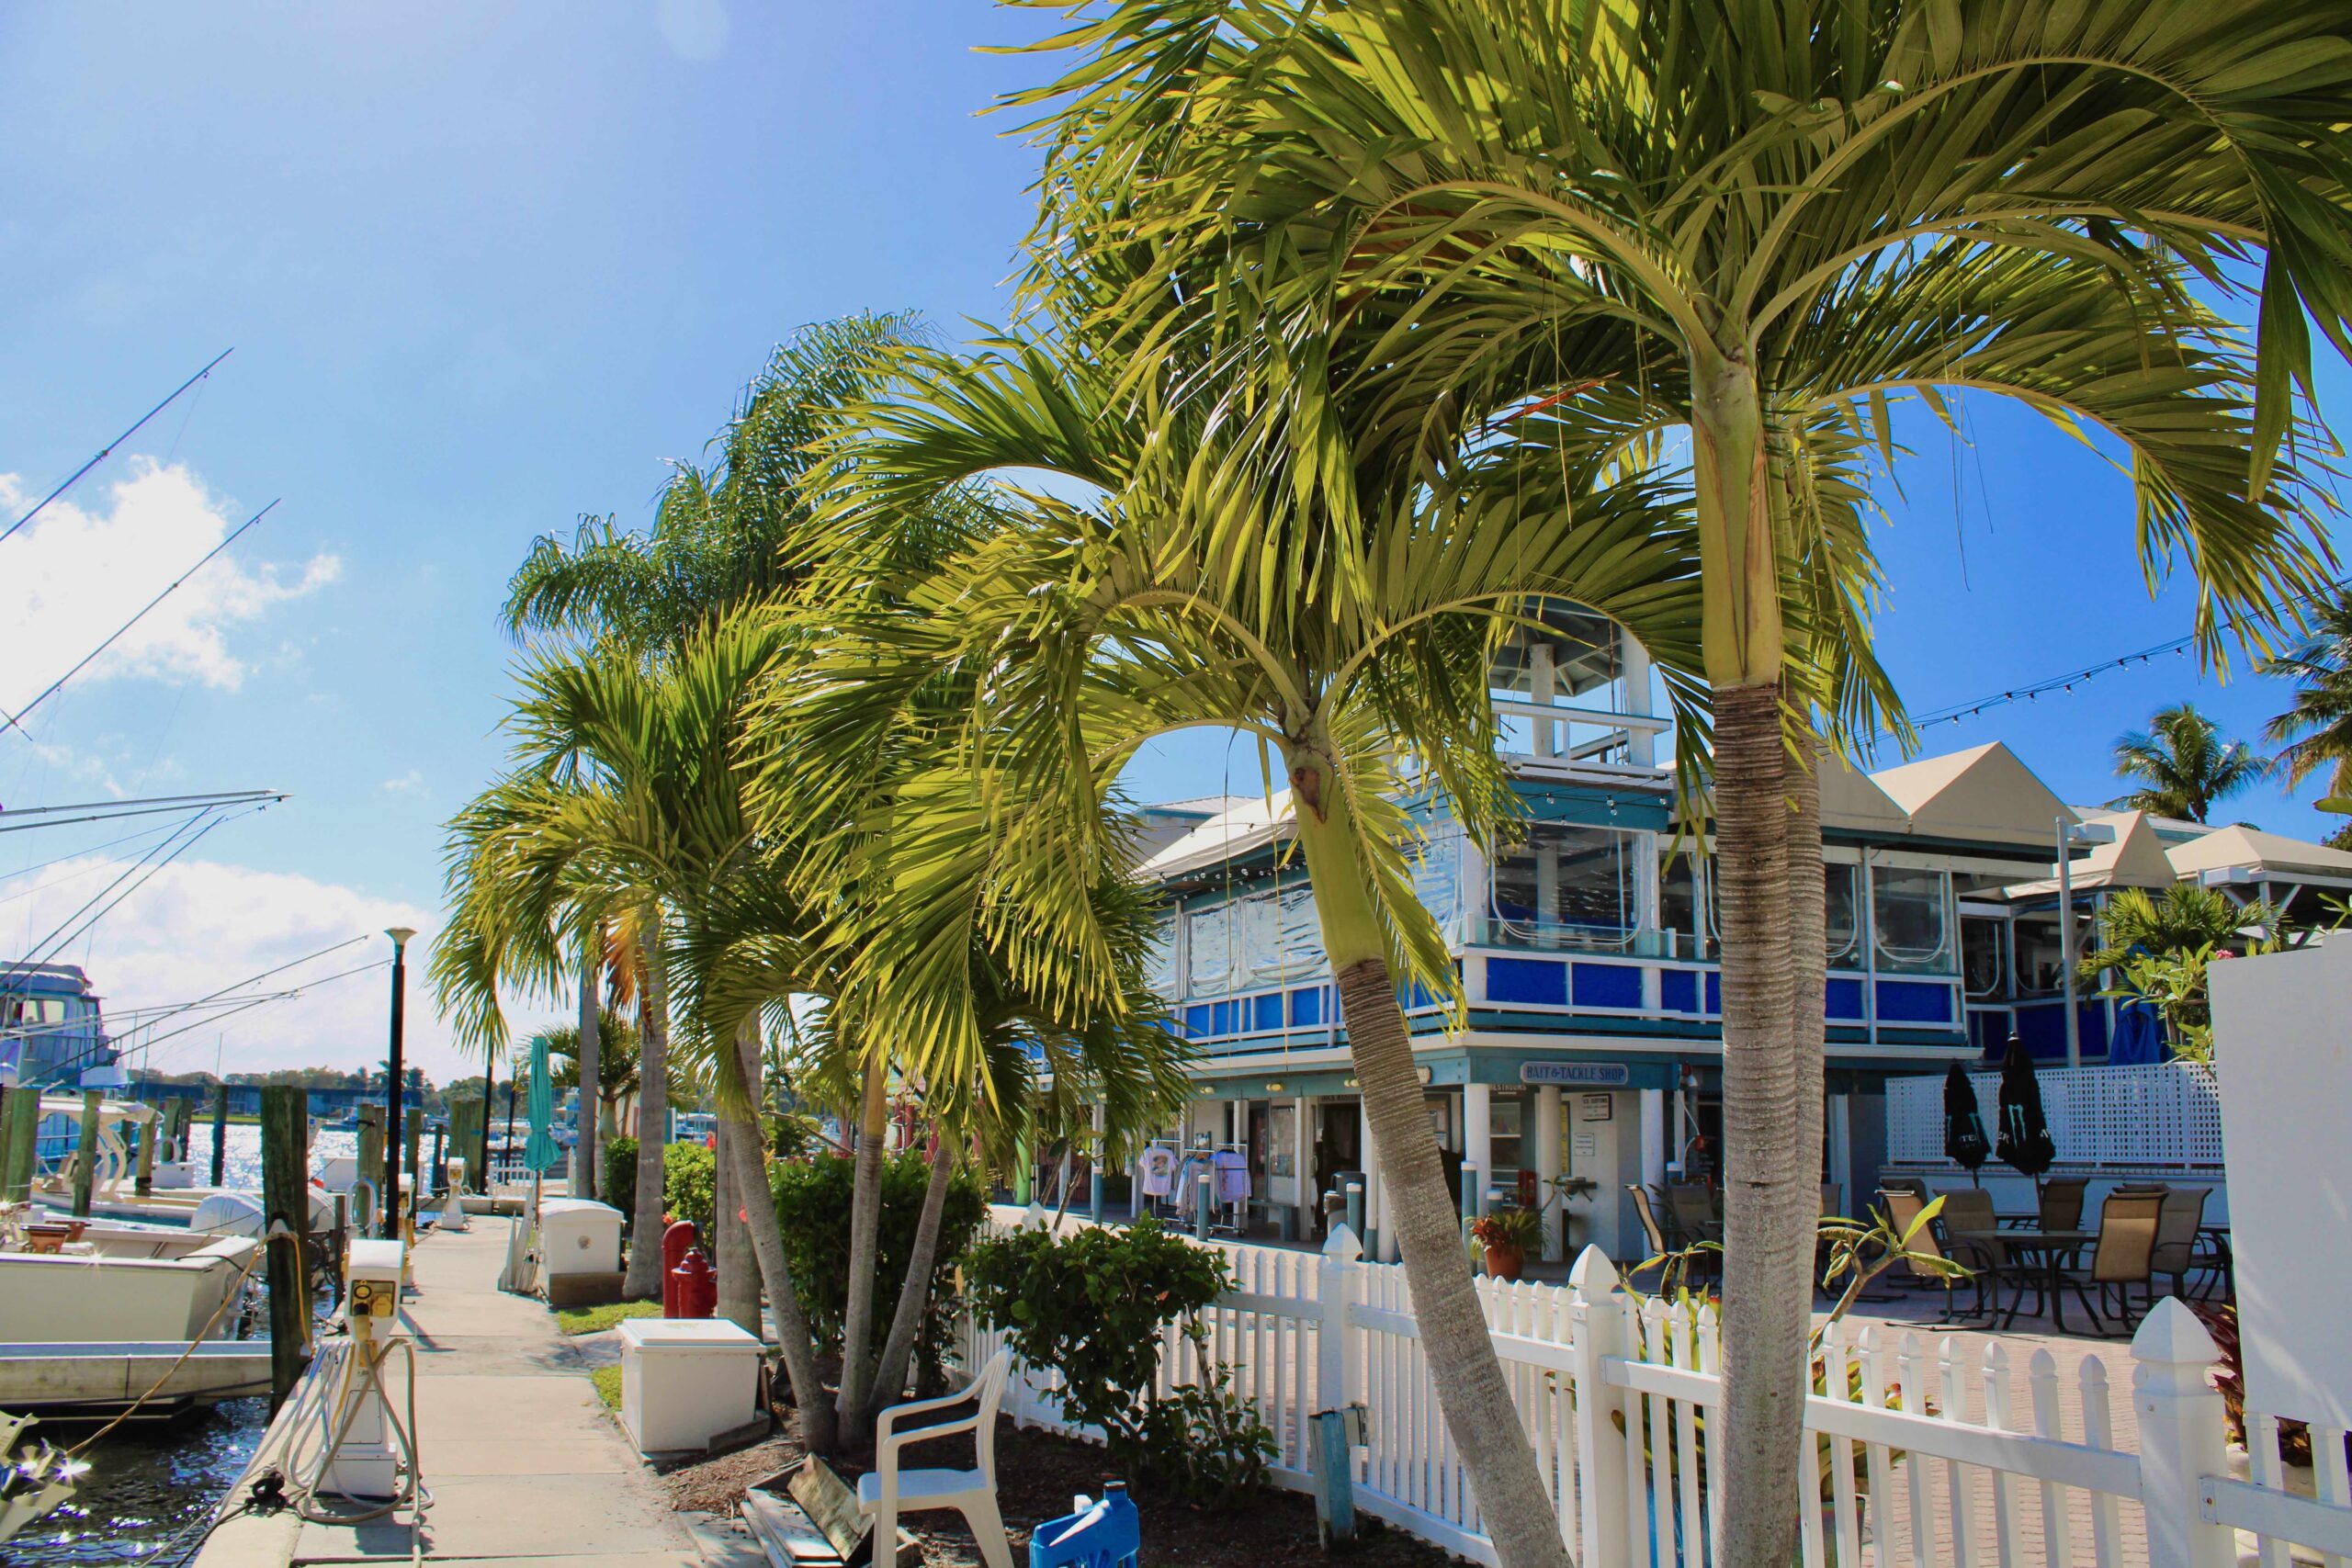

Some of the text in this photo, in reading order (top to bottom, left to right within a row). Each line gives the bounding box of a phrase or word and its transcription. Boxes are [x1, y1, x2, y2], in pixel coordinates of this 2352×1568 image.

[1526, 1066, 1551, 1078] BAIT
[1560, 1066, 1597, 1080] TACKLE
[1599, 1068, 1625, 1081] SHOP
